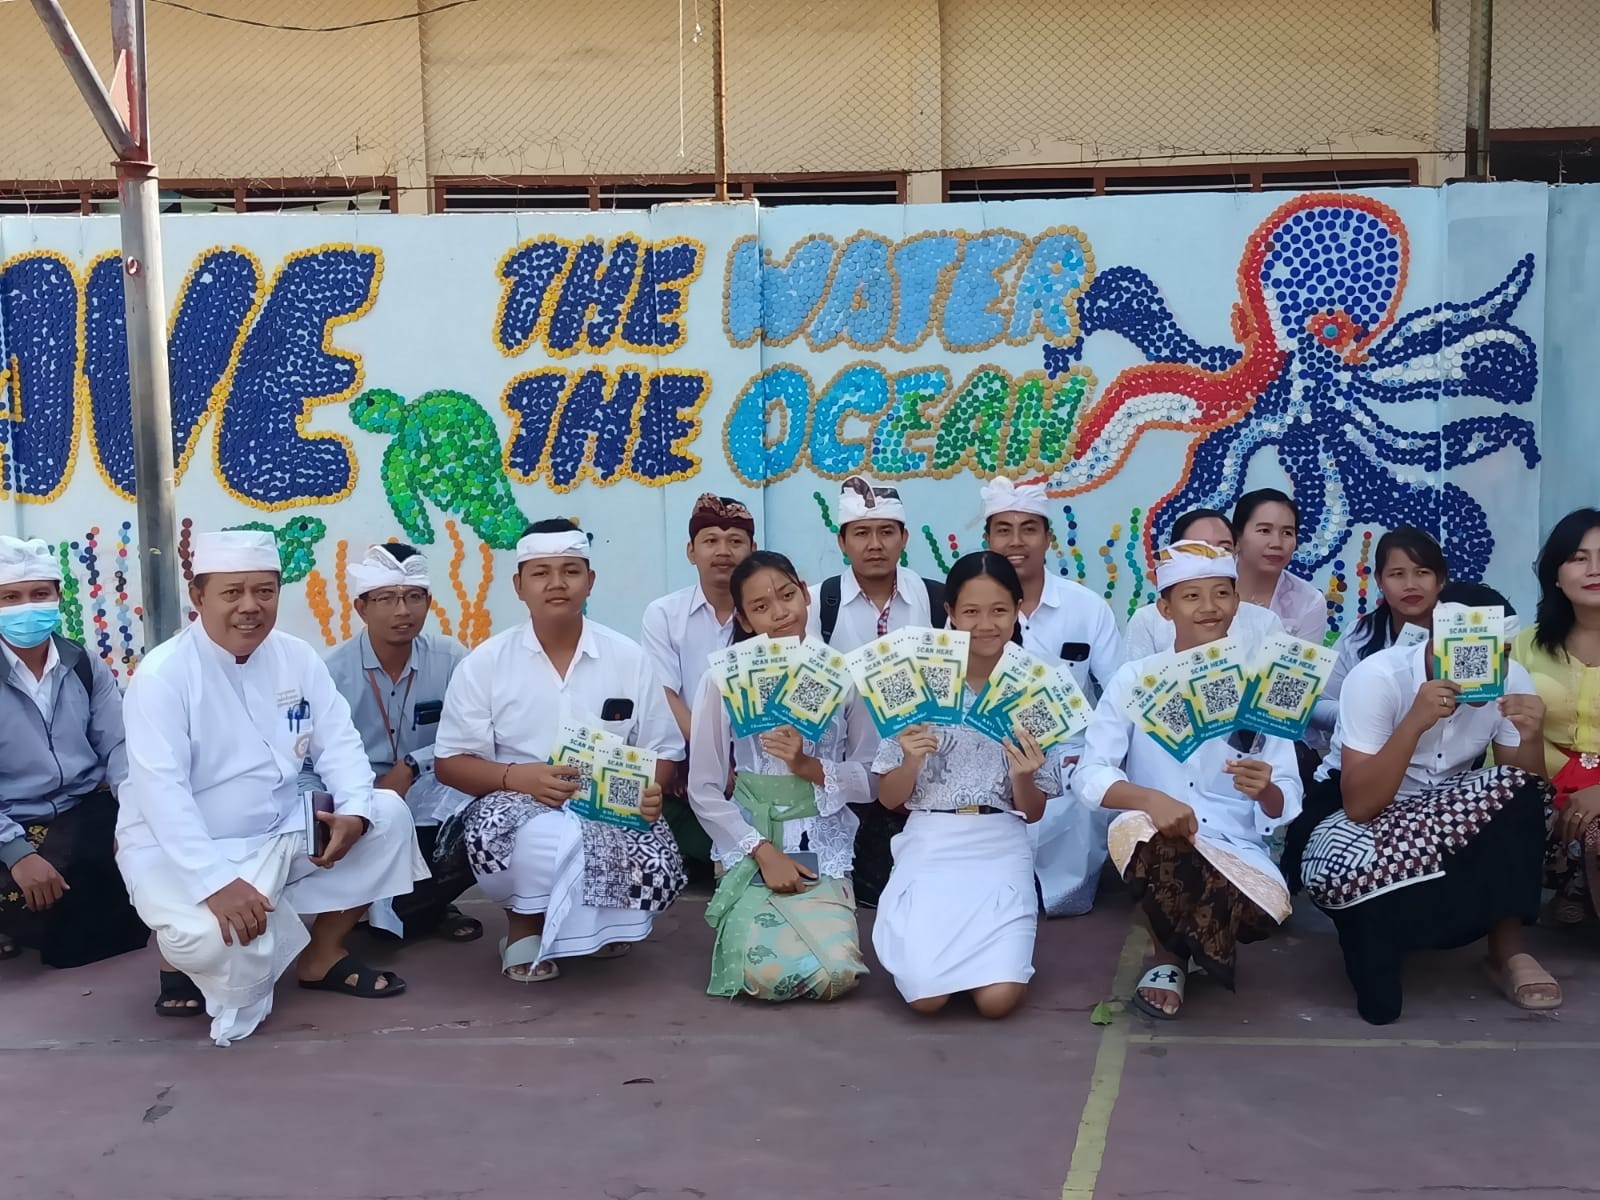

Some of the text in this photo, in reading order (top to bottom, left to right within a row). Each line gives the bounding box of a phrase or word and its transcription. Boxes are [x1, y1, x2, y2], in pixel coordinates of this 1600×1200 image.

[493, 224, 1097, 358] THE WATER
[500, 360, 1097, 494] THE OCEAN
[1469, 626, 1488, 634] HERE
[916, 646, 954, 656] SCAN HERE
[726, 664, 739, 673] SCA
[751, 656, 788, 666] SCAN HERE
[808, 657, 841, 680] SCAN HERE
[864, 651, 900, 672] SCAN HERE
[1190, 657, 1229, 675] SCAN HERE
[1279, 653, 1317, 671] SCAN HERE
[1051, 685, 1075, 719] SCAN HERE
[1138, 679, 1169, 710] SCAN HERE
[570, 738, 587, 748] SCAN
[607, 759, 642, 771] SCAN HERE
